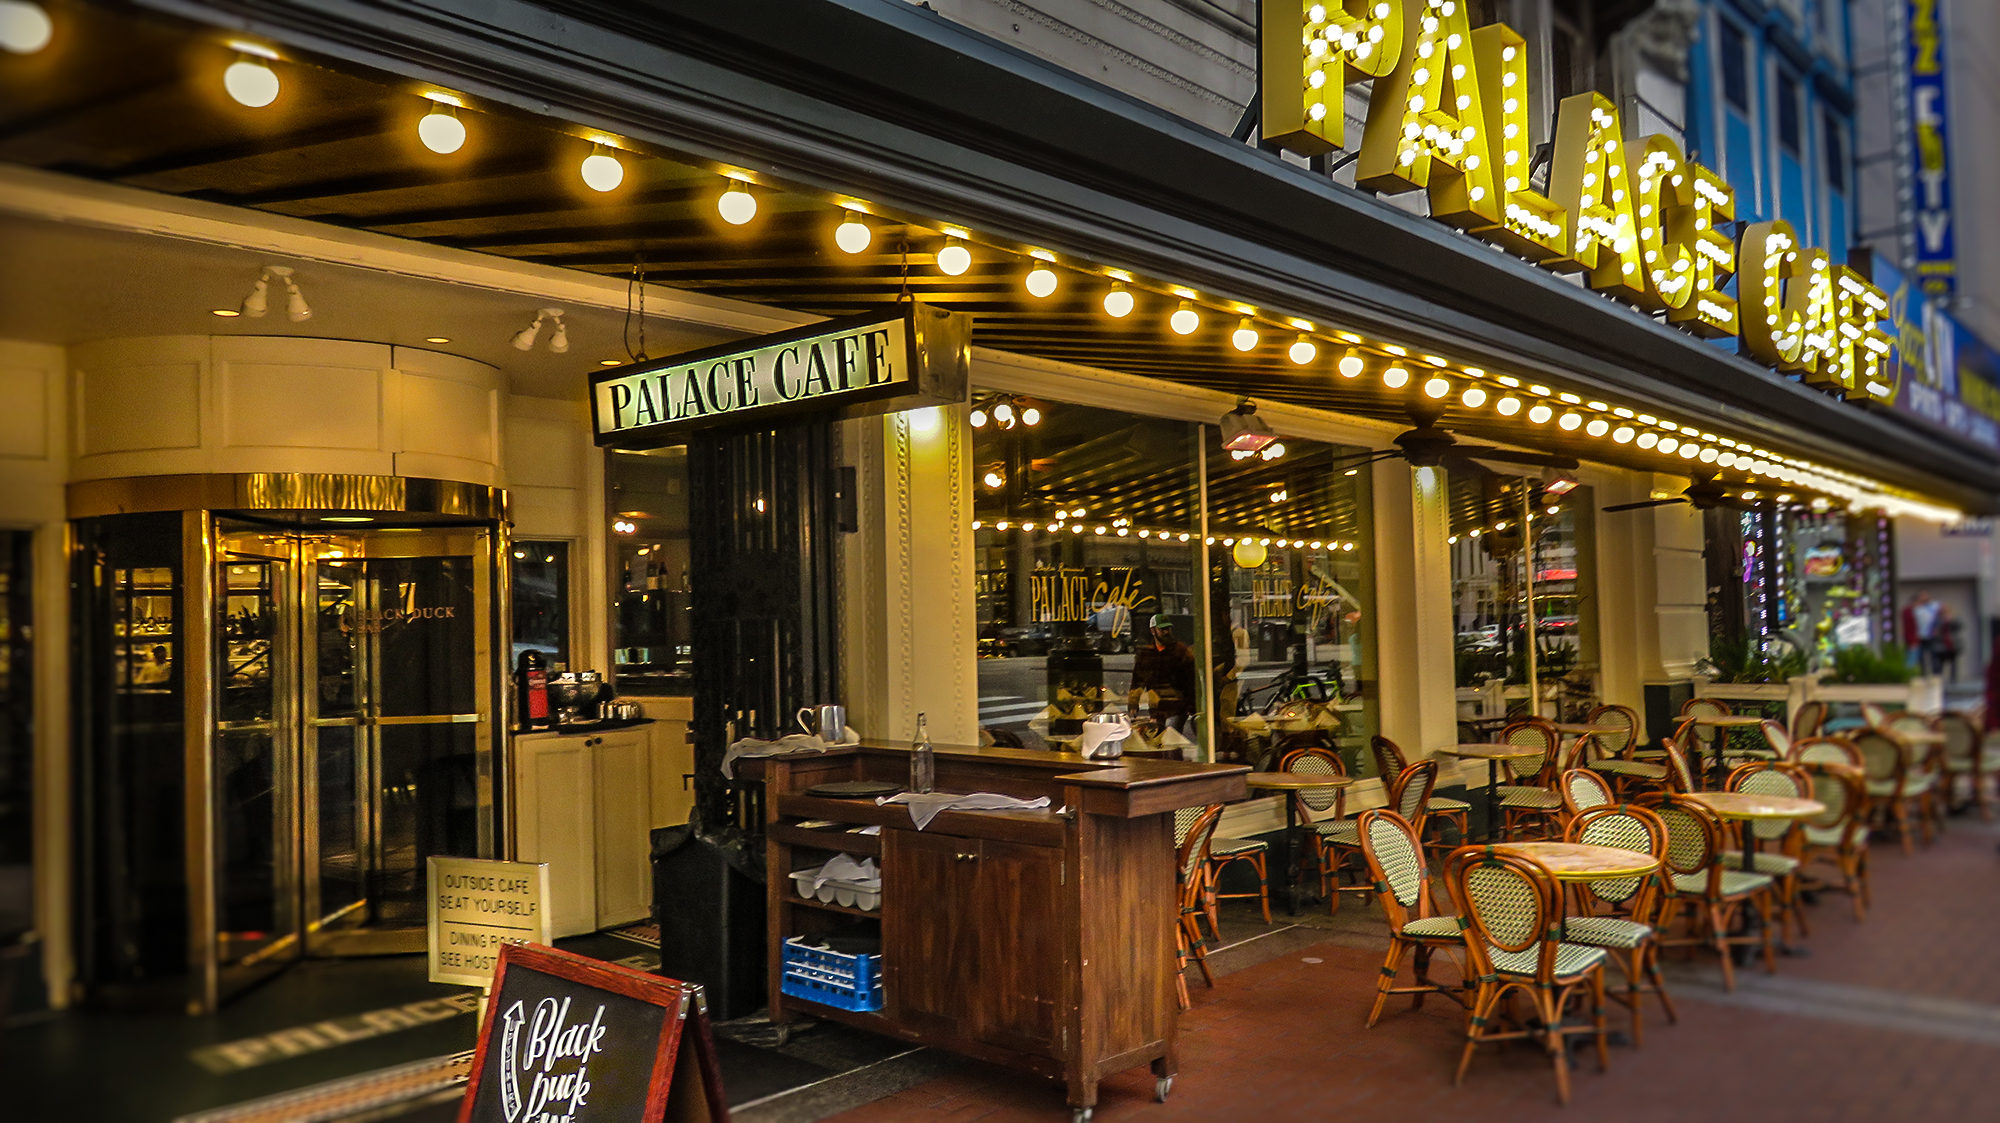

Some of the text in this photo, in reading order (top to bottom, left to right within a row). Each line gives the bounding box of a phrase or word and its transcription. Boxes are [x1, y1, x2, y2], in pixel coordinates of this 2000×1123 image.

[1262, 0, 1739, 336] PALACE
[1738, 219, 1896, 402] CAFE
[609, 328, 893, 431] PALACE CAFE
[412, 606, 455, 619] DUCK
[1030, 575, 1089, 622] PALACE
[445, 874, 494, 892] OUTSIDE
[440, 895, 537, 917] SEAT YOURSELF
[450, 931, 487, 948] DINING
[440, 951, 462, 967] SEE
[217, 992, 477, 1068] PALACE
[523, 996, 607, 1072] Black
